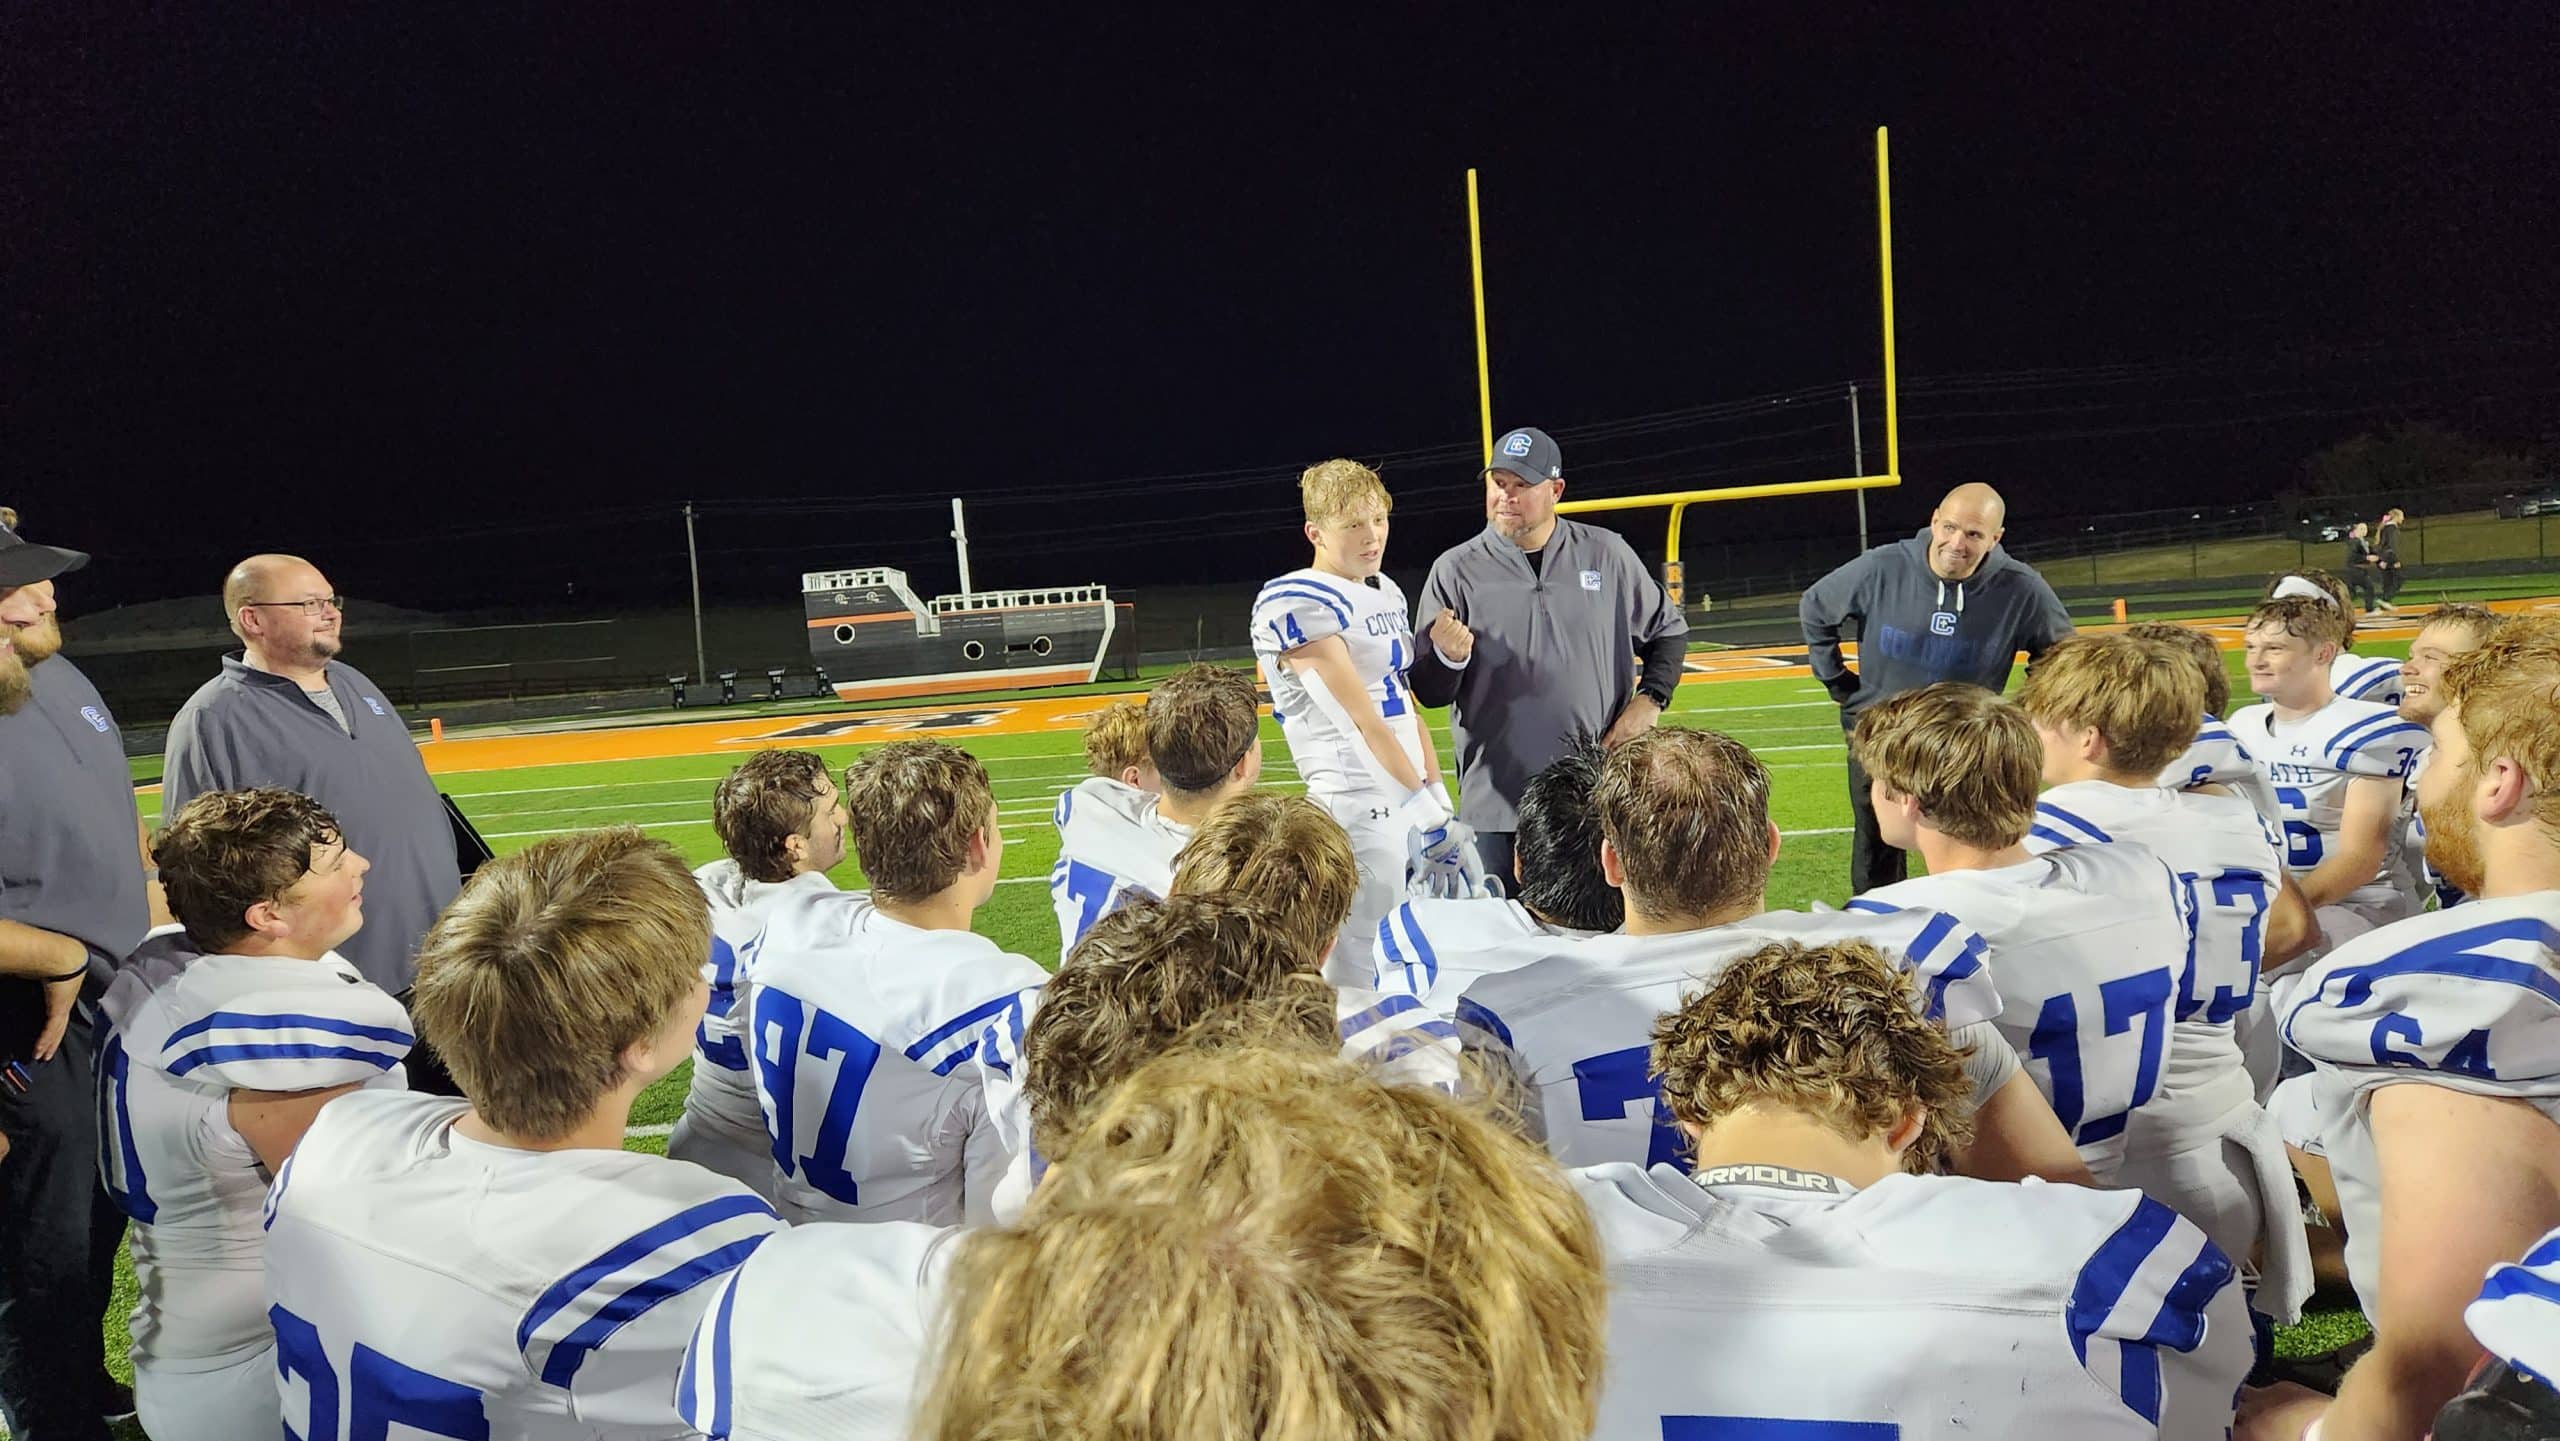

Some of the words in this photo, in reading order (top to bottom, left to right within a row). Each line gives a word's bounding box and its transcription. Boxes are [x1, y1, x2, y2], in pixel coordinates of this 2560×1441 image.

[1269, 611, 1308, 651] 14
[1930, 611, 1957, 636] C
[2175, 867, 2269, 1024] 13
[2029, 965, 2173, 1147] 17
[2370, 1011, 2497, 1082] 64
[754, 985, 881, 1206] 97
[1692, 1164, 1829, 1192] ARMOUR
